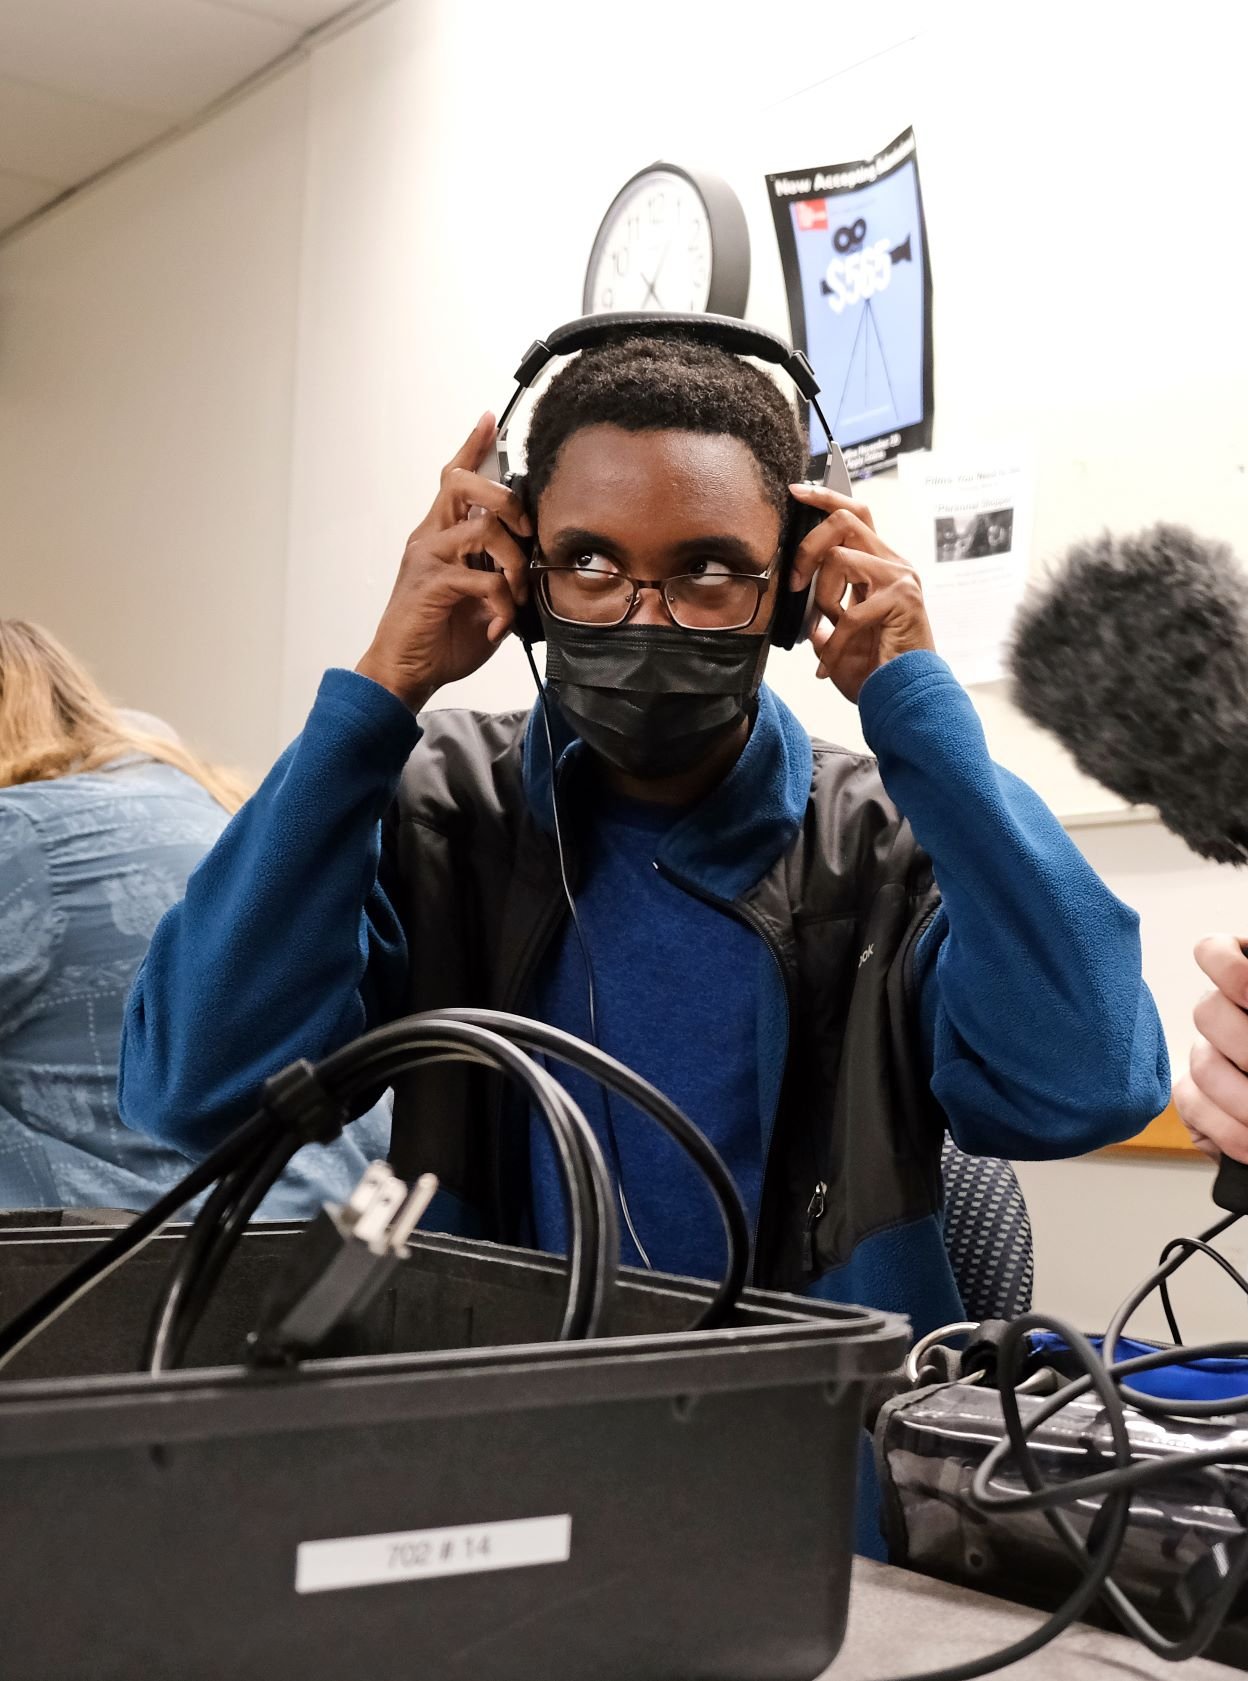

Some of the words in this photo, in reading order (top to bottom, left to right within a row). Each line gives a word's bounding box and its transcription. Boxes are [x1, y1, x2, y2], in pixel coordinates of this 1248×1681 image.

[774, 178, 812, 197] Now
[813, 164, 877, 191] Accepting
[387, 1541, 432, 1569] 702
[465, 1535, 492, 1559] 14
